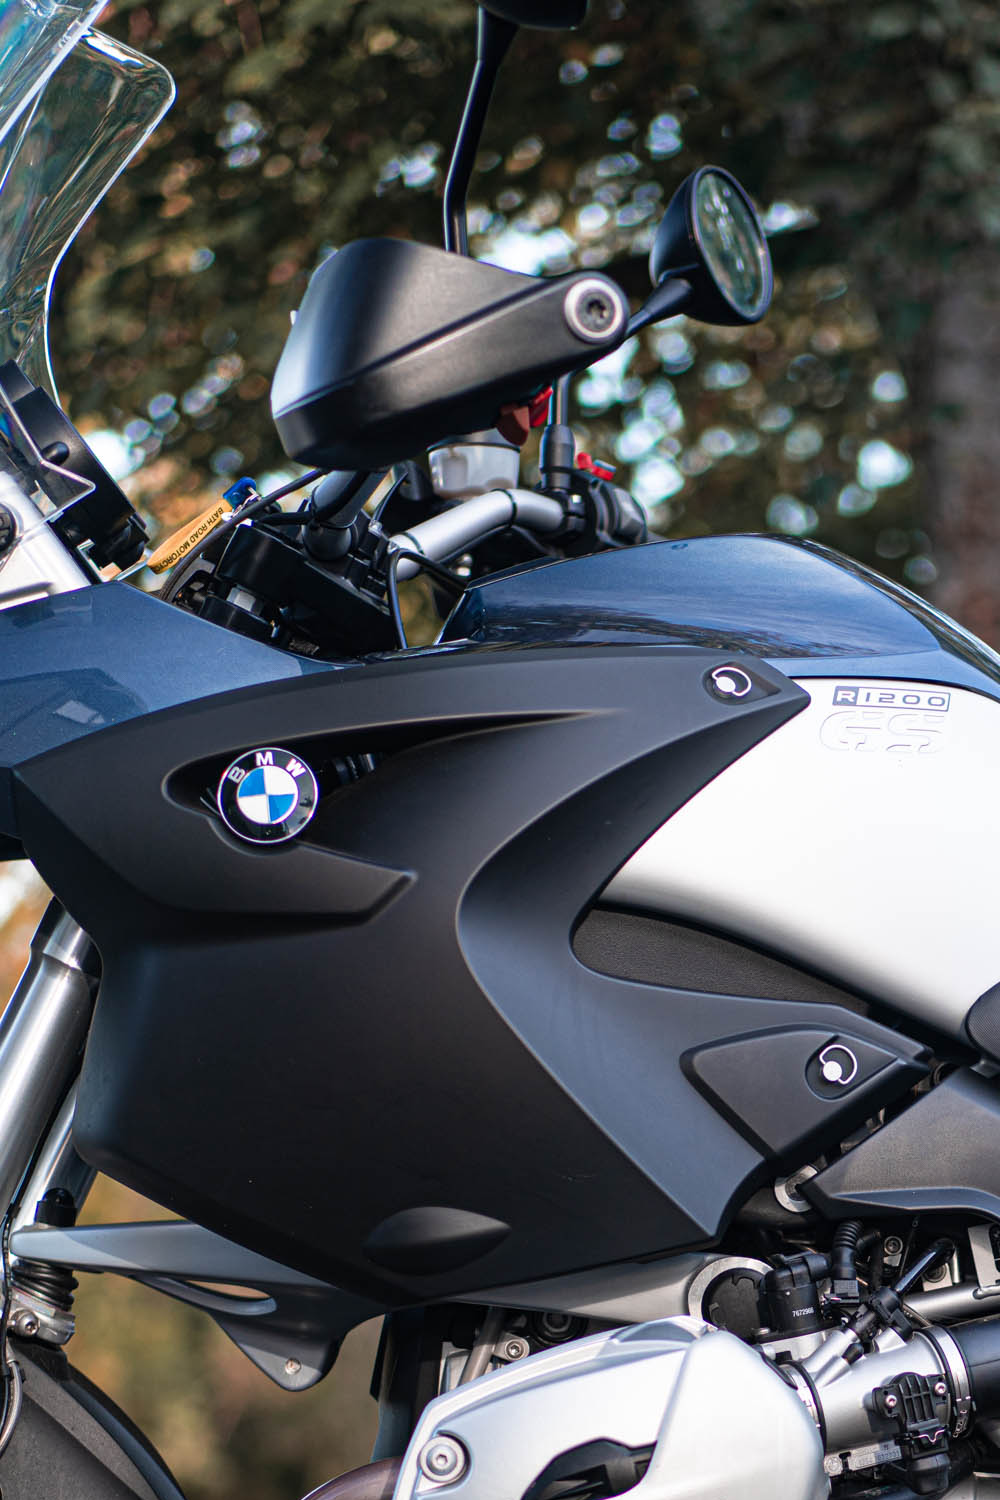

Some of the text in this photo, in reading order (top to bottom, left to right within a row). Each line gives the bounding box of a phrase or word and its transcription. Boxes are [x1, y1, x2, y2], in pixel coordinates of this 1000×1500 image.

[207, 507, 223, 525] BATH
[190, 523, 208, 543] ROAD
[835, 689, 946, 707] R1200
[820, 710, 945, 753] GS
[227, 751, 307, 784] BMW
